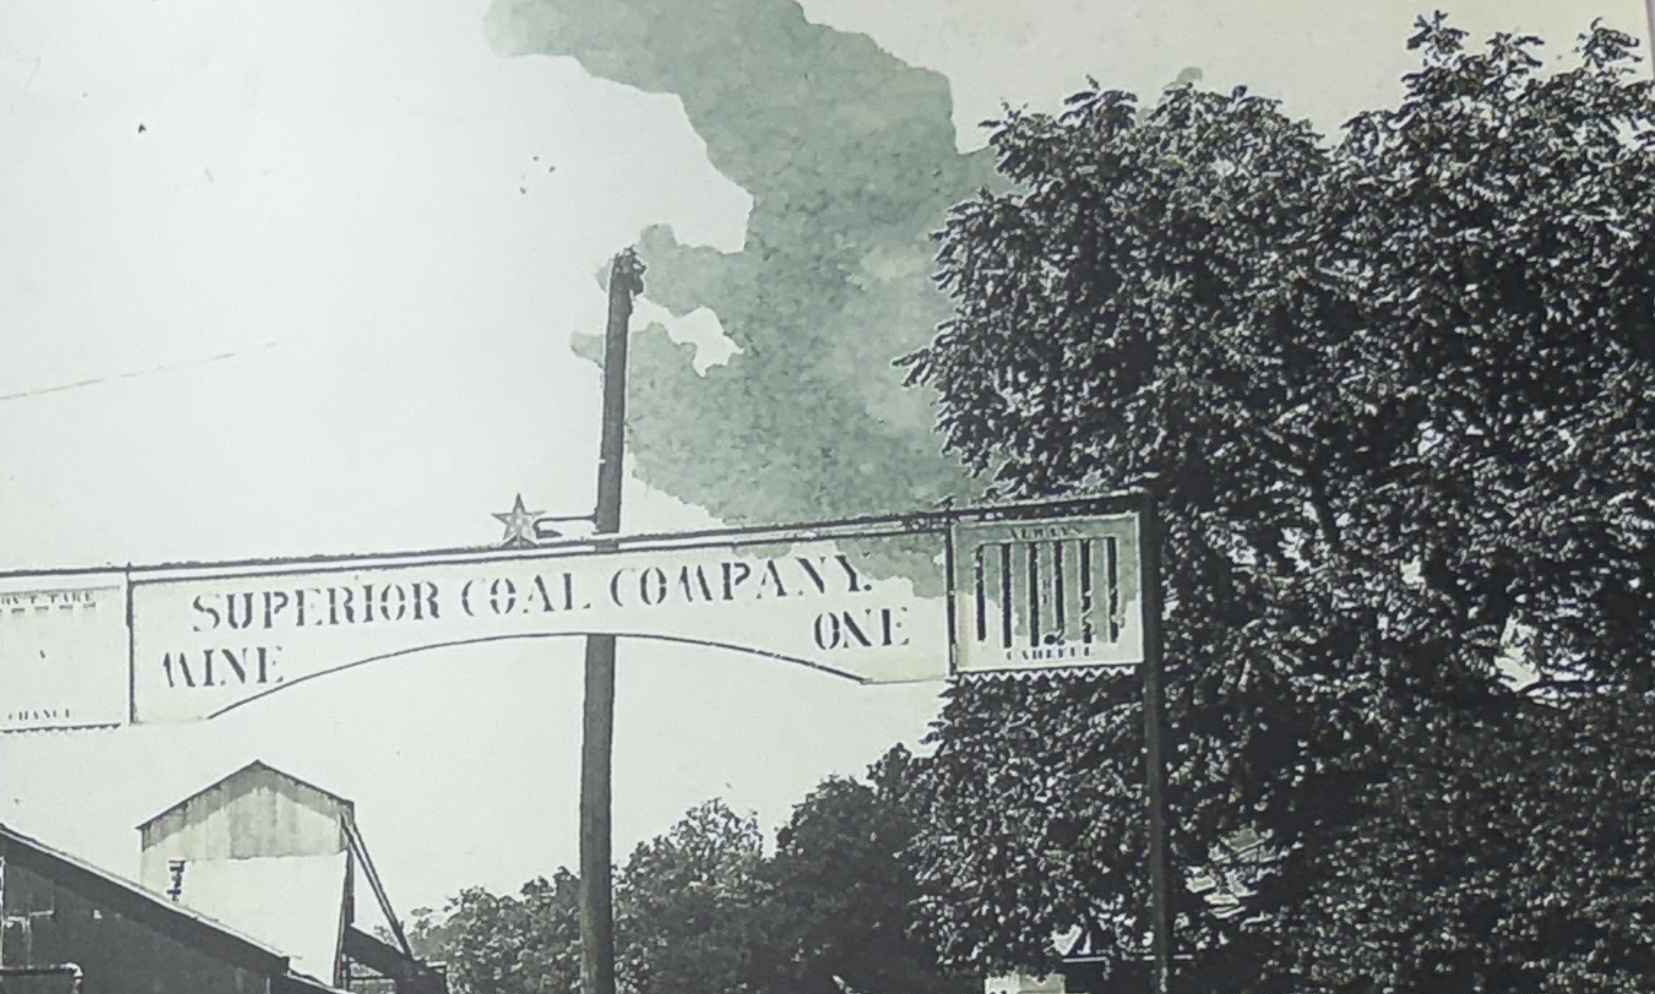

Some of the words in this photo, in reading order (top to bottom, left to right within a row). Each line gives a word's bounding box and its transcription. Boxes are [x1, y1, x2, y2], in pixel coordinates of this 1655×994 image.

[192, 580, 441, 633] SUPERIOR
[460, 572, 591, 616] COAL
[609, 554, 873, 607] COMPANY.
[813, 606, 910, 651] ONE
[162, 645, 285, 688] MINE
